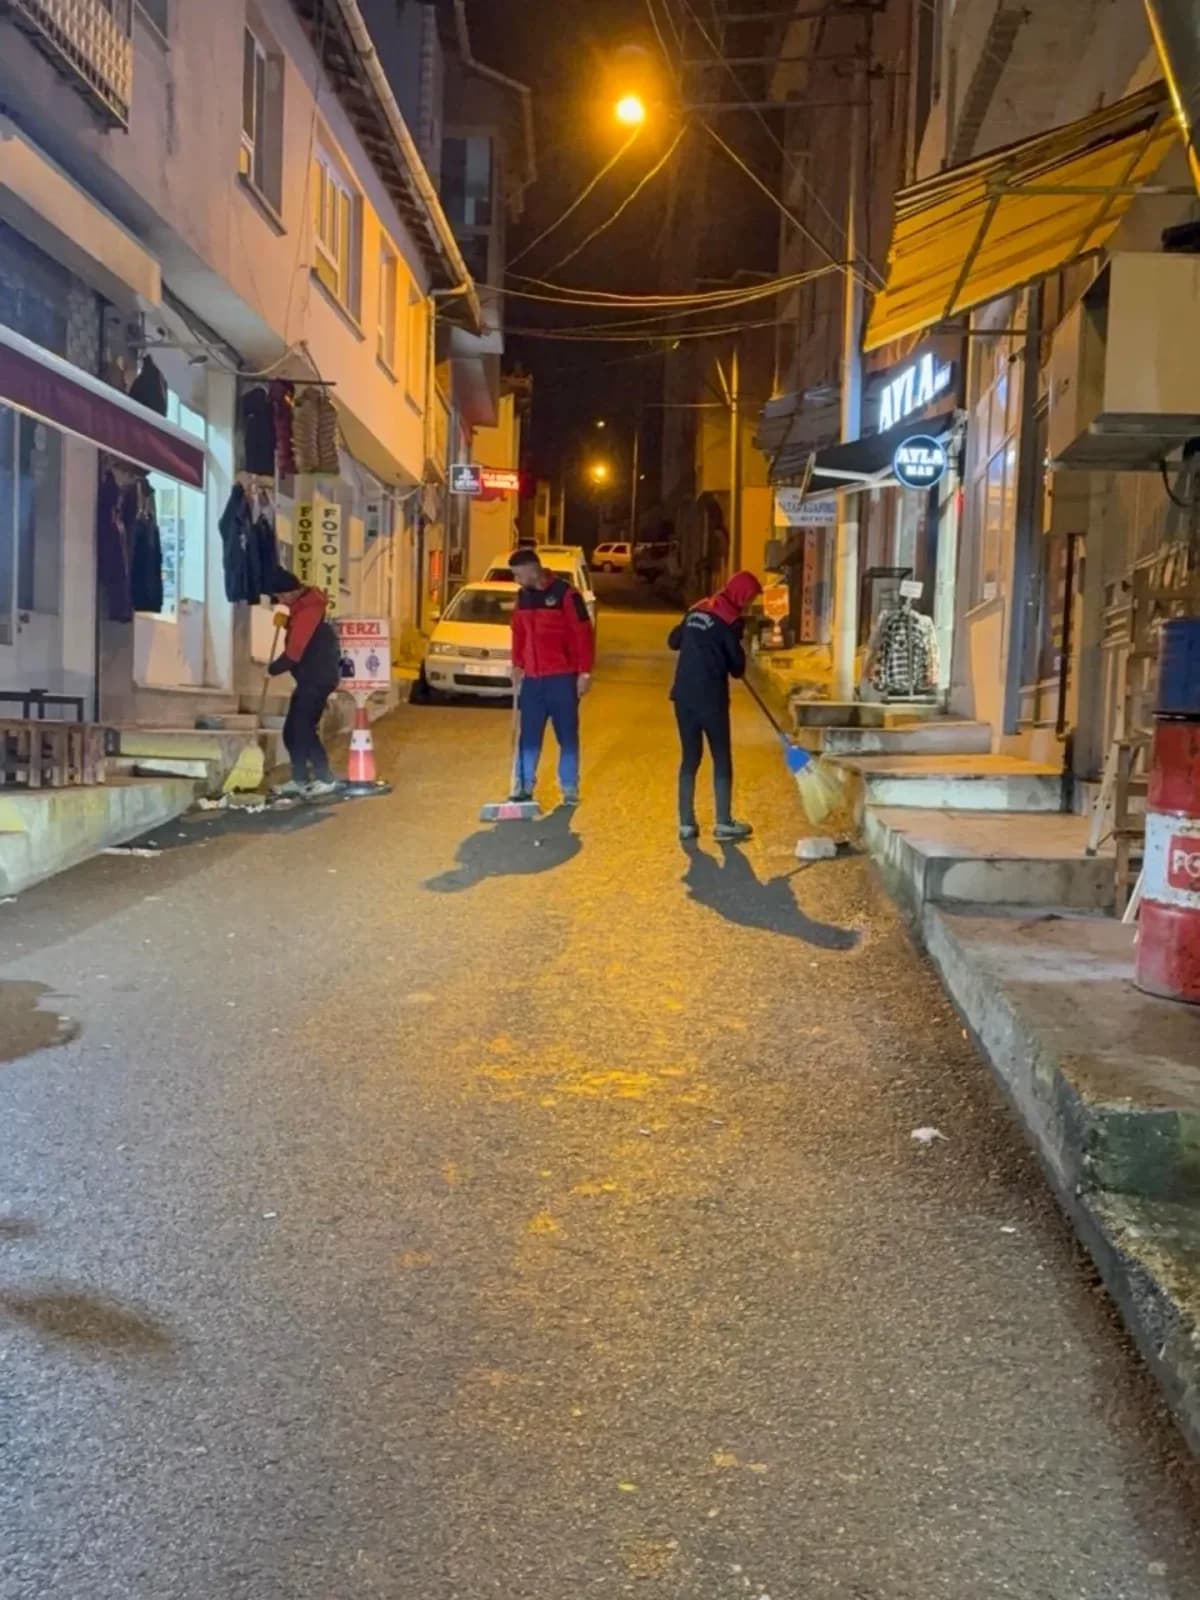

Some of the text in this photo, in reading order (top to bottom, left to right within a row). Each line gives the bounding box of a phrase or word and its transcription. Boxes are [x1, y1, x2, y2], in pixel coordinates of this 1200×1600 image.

[878, 352, 933, 435] AYLA
[897, 447, 944, 465] AYLA
[298, 505, 312, 553] FOTO
[322, 508, 338, 555] FOTO
